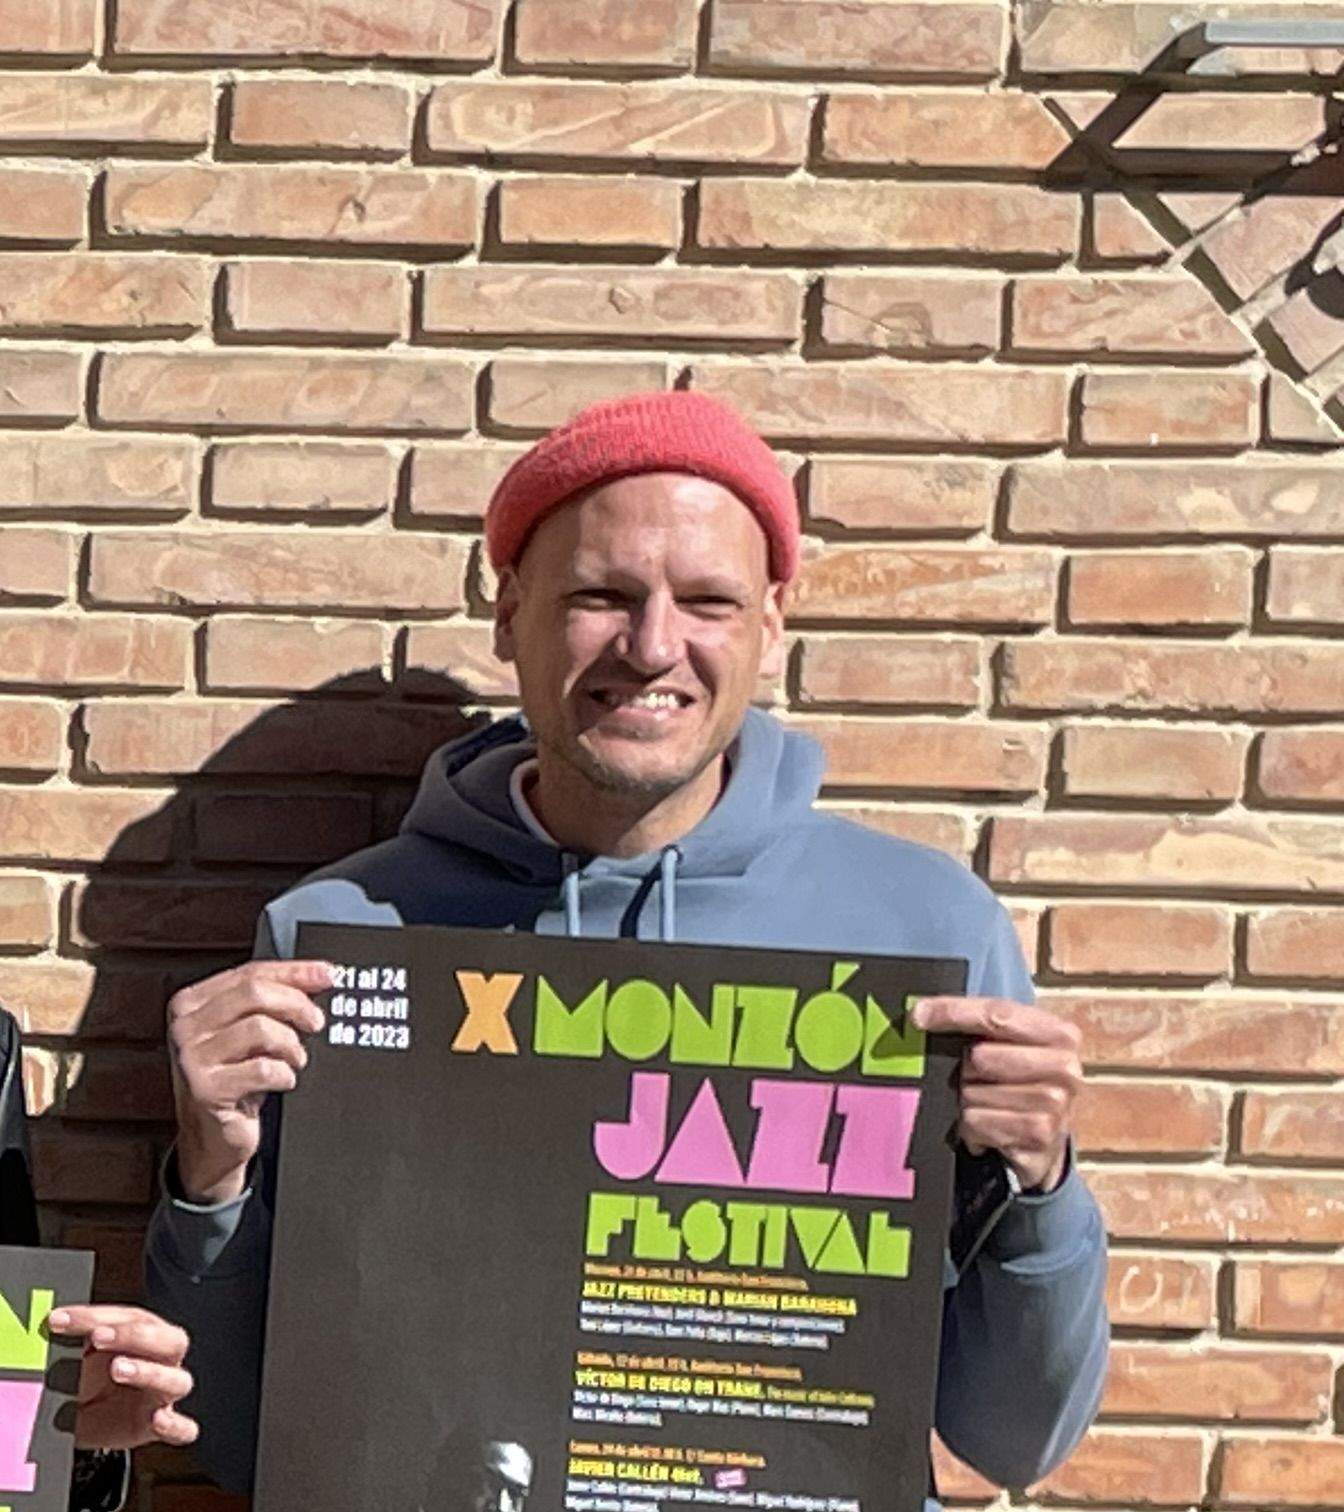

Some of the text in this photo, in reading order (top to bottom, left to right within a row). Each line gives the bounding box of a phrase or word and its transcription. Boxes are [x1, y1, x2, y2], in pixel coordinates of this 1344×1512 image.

[331, 994, 409, 1020] de abril
[358, 968, 379, 990] al
[381, 967, 407, 992] 24
[329, 1022, 410, 1049] de 2023
[452, 963, 923, 1076] X MONZÓN
[593, 1072, 921, 1198] JAZZ
[585, 1192, 912, 1278] FESTIVAL
